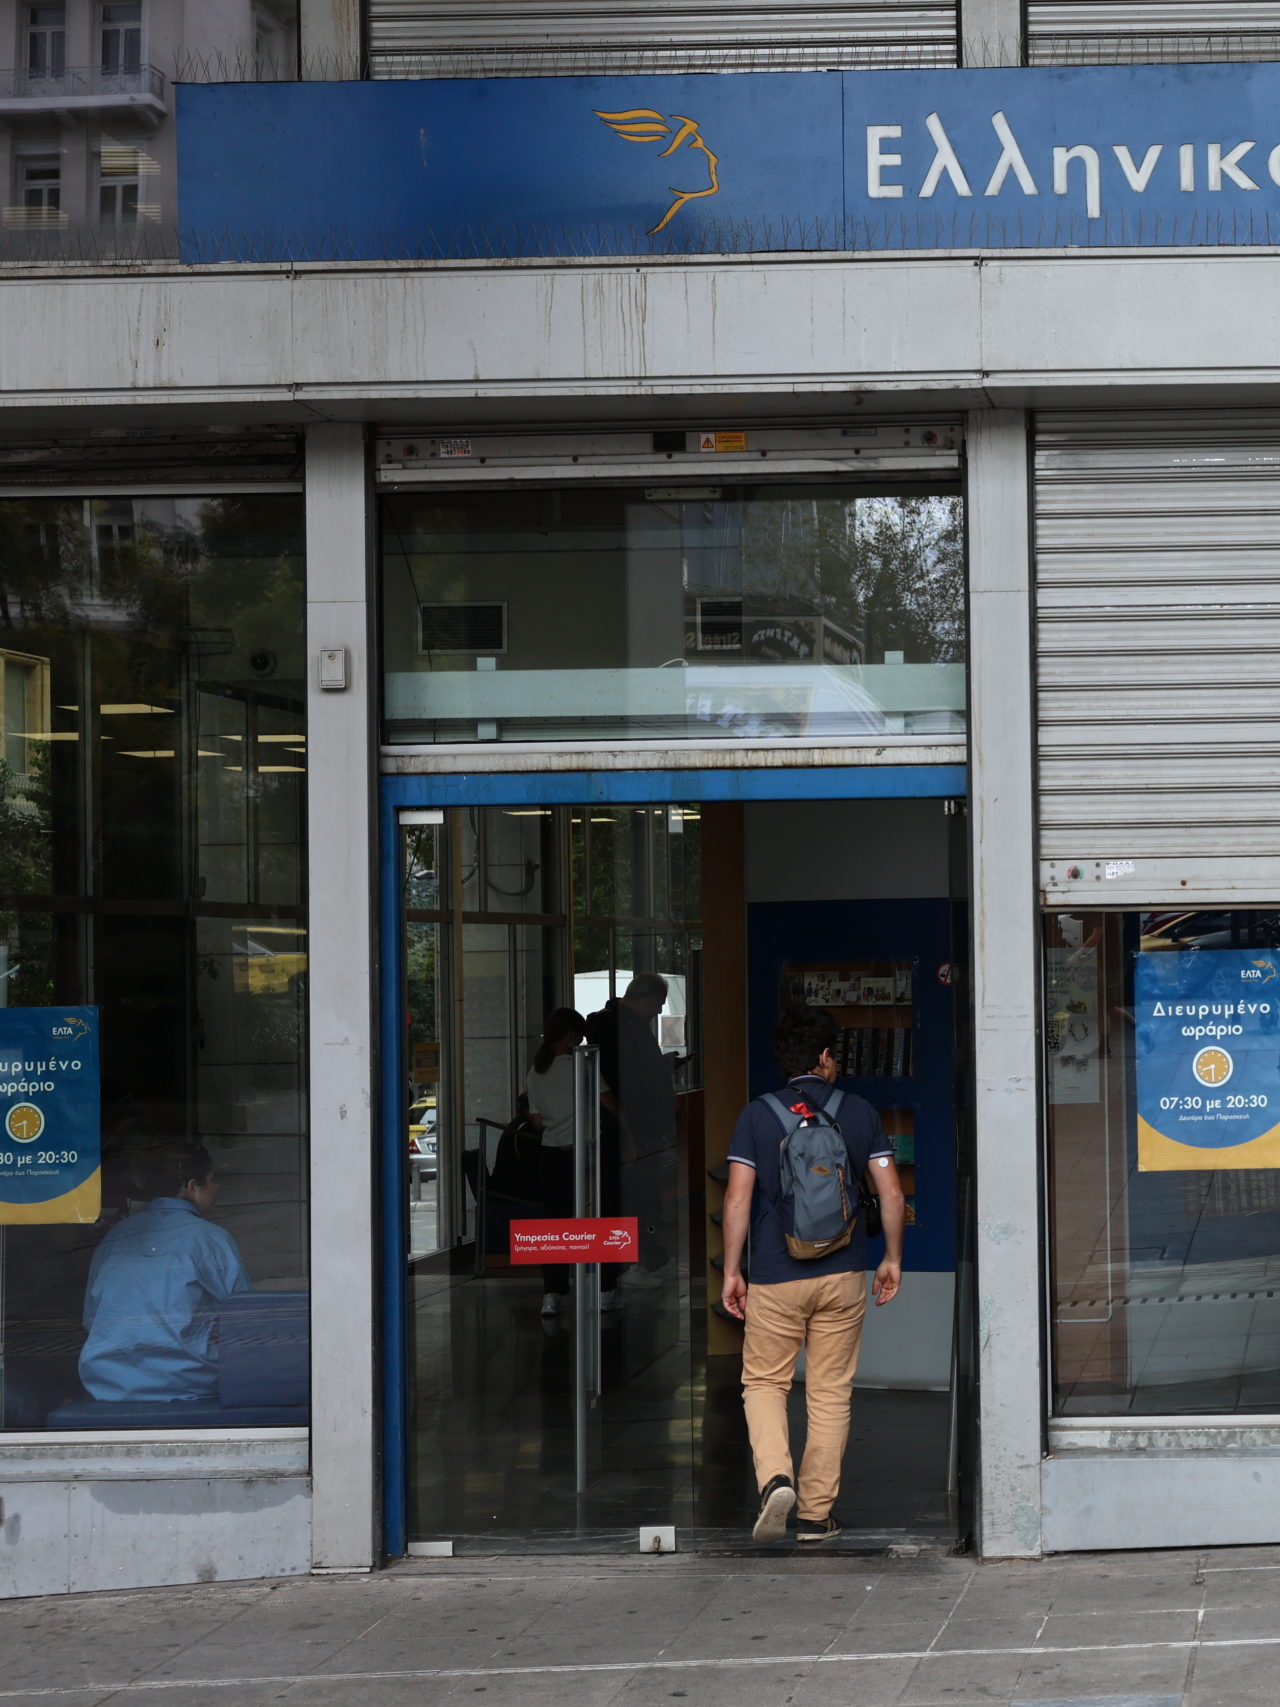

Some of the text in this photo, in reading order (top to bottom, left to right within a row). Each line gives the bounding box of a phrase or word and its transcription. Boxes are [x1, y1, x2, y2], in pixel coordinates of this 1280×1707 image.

[1240, 969, 1262, 979] ΕΛΤΑ
[1153, 1000, 1271, 1019] Διευρυμένο
[52, 1026, 73, 1036] ΕΛΤΑ
[1182, 1021, 1243, 1040] ωράριο
[1160, 1095, 1268, 1112] 07:30 με 20:30
[17, 1155, 33, 1168] με
[37, 1151, 78, 1164] 20:30
[514, 1231, 597, 1243] Υπηρεσίες Courier
